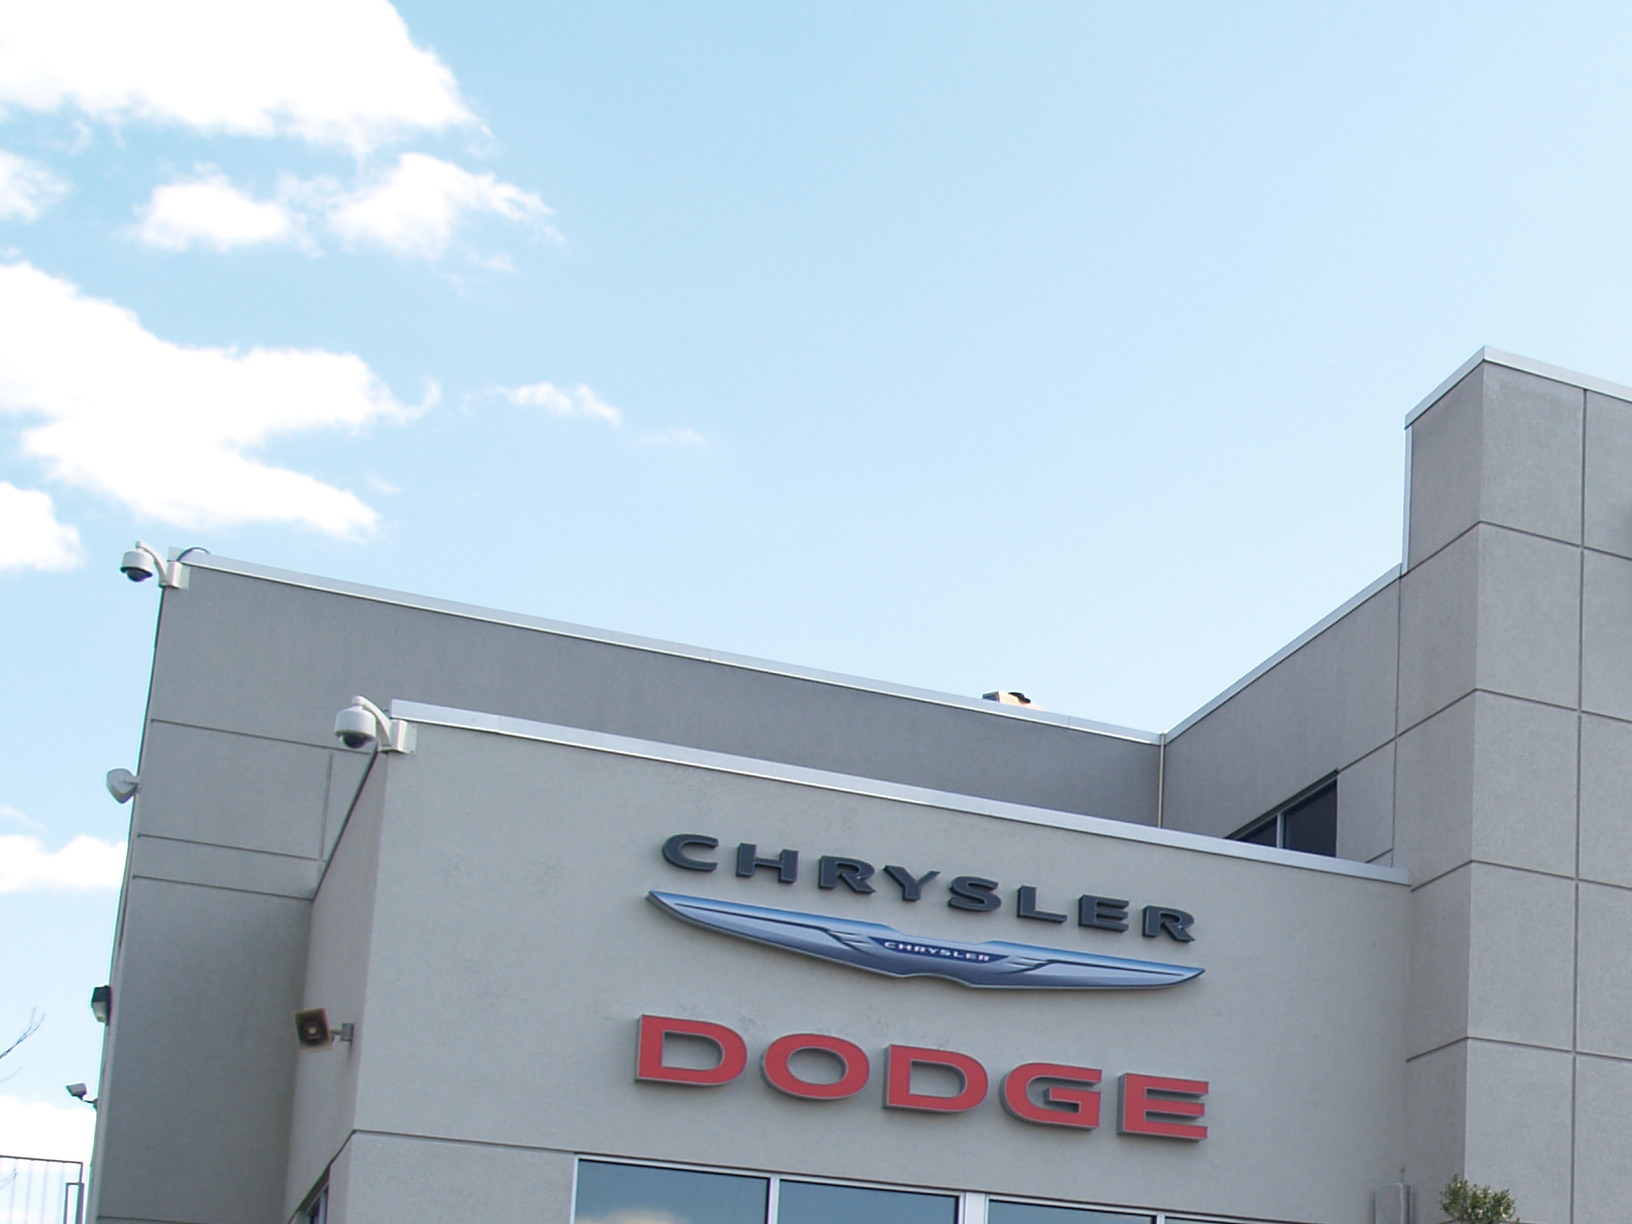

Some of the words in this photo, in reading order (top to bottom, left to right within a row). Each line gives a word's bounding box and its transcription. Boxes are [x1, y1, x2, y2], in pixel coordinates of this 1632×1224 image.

[662, 833, 1195, 942] CHRYSLER
[884, 941, 990, 961] CHRYSLER
[634, 1014, 1209, 1141] DODGE
